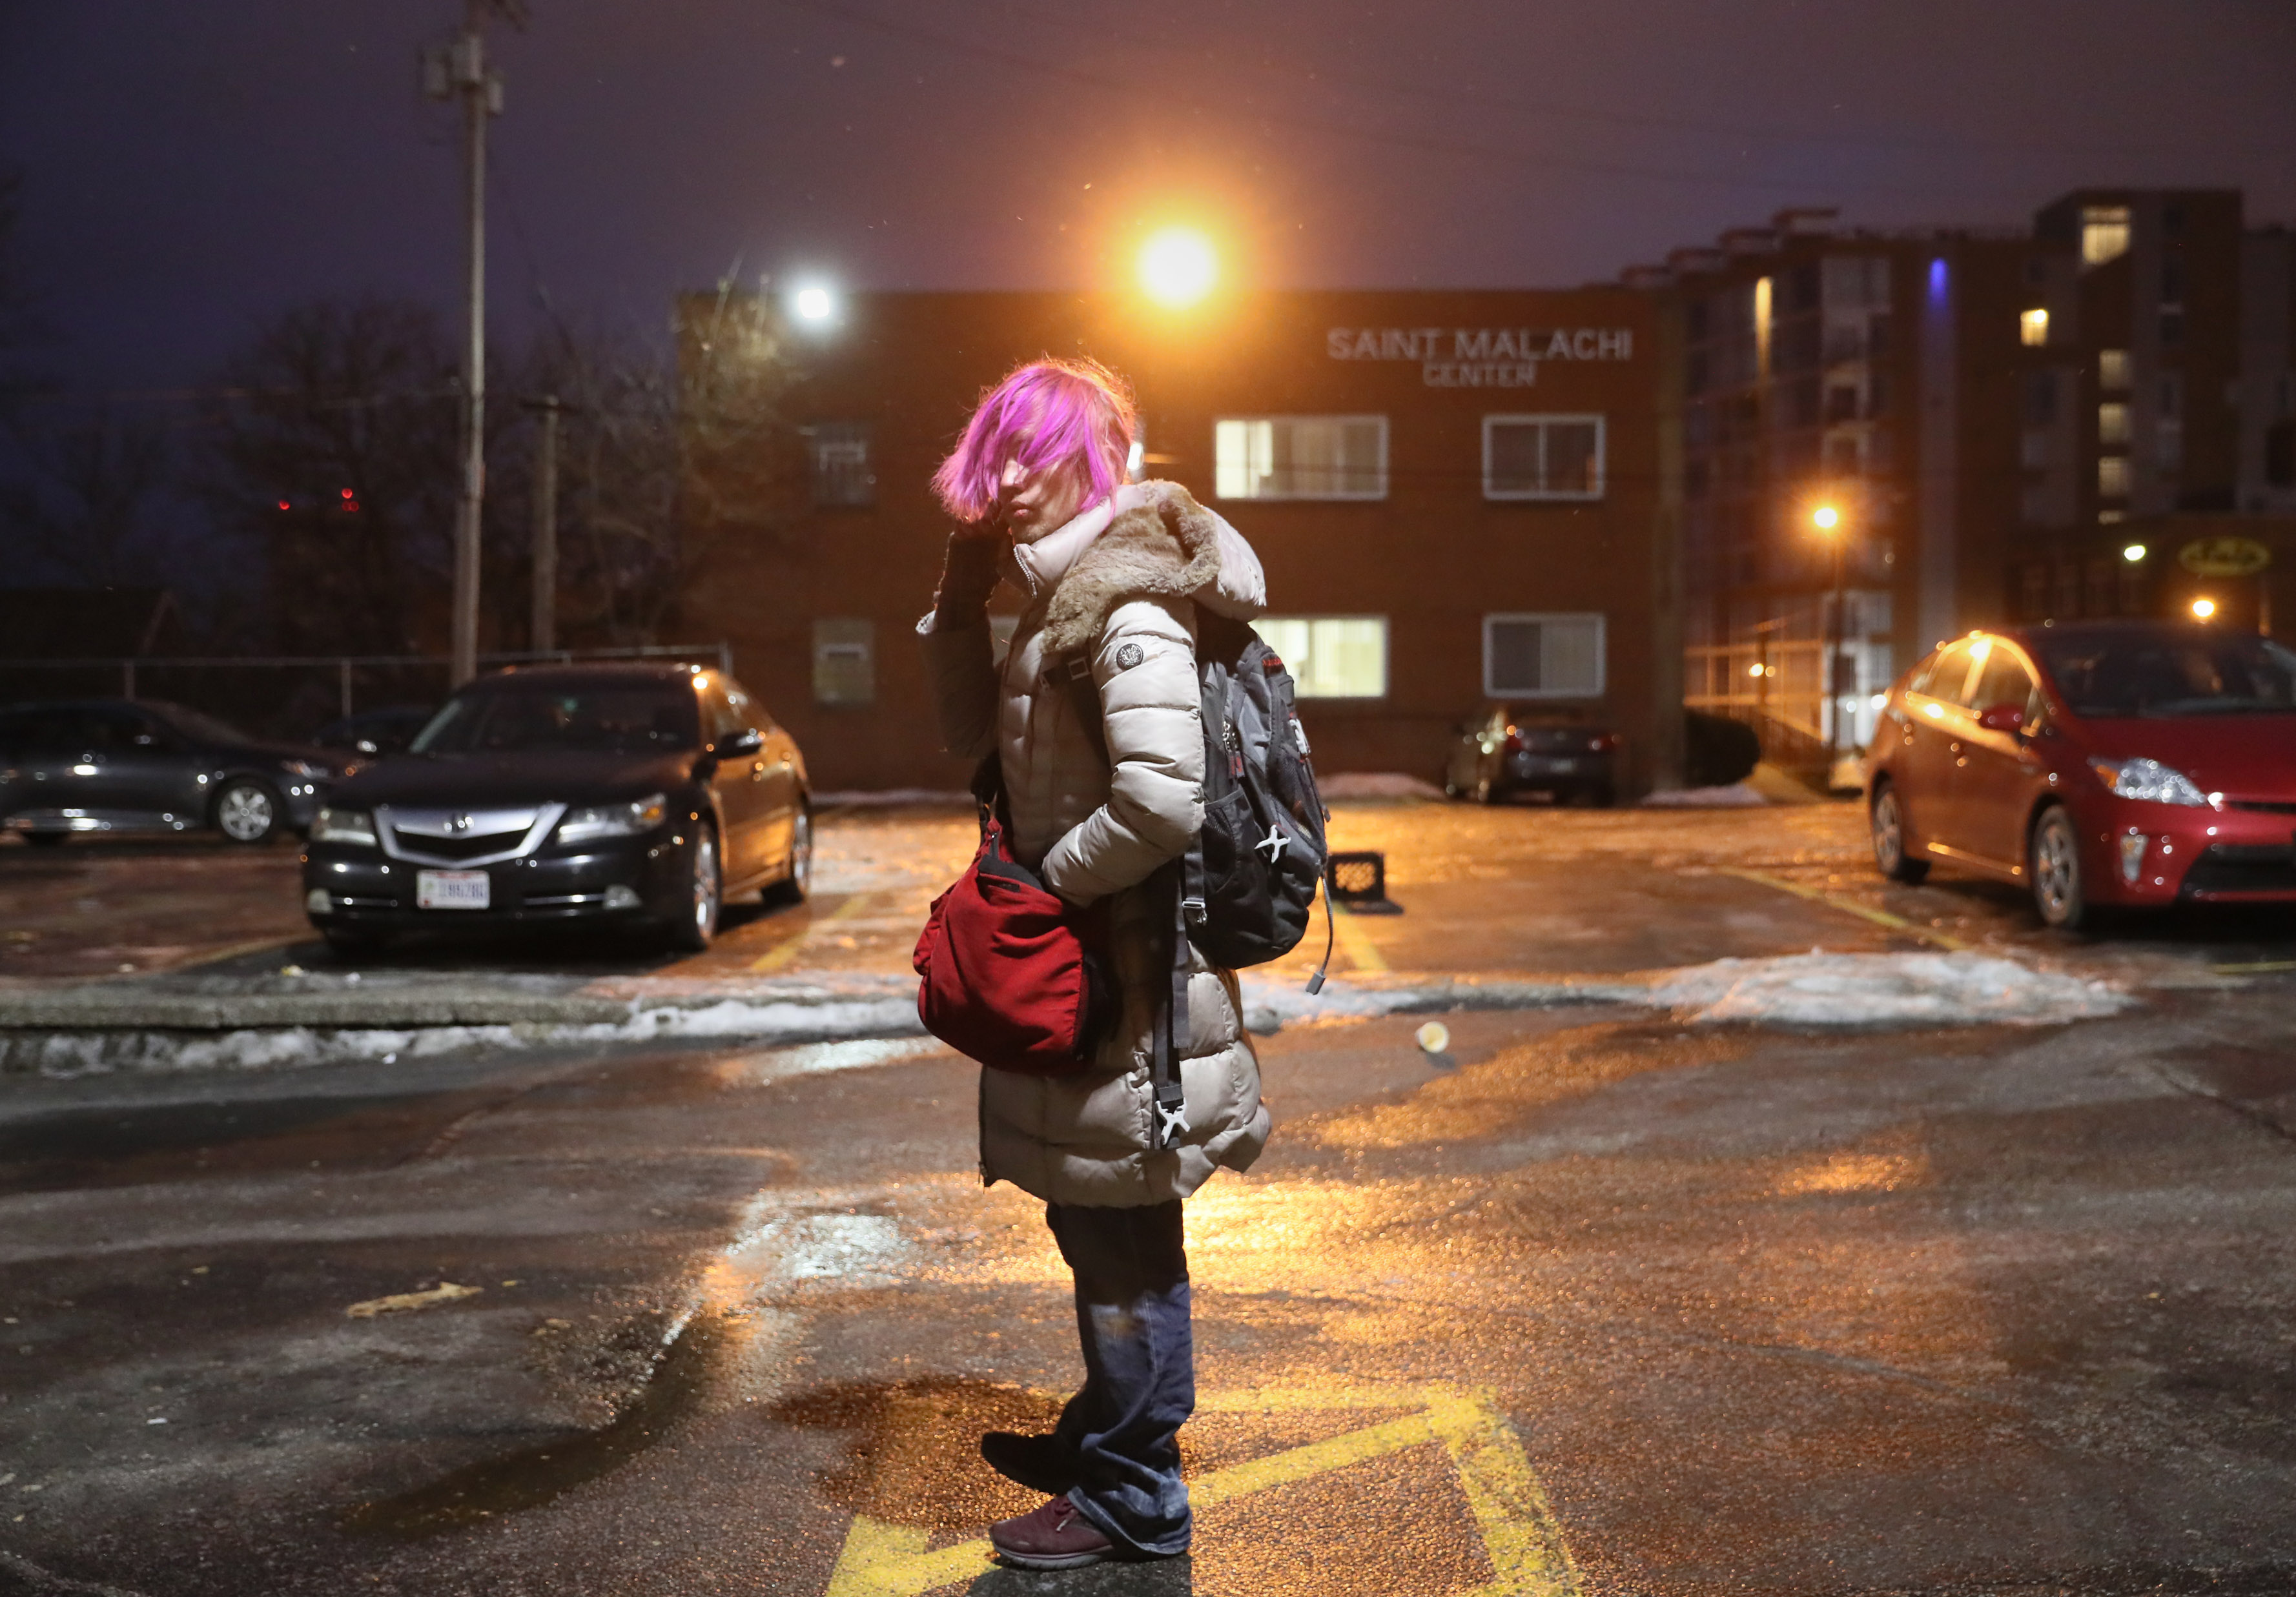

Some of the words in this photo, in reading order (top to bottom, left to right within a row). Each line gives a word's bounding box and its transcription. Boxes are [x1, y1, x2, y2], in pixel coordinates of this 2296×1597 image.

[1327, 328, 1441, 360] SAINT
[1456, 328, 1632, 361] MALACHI
[1424, 363, 1537, 387] CENTER
